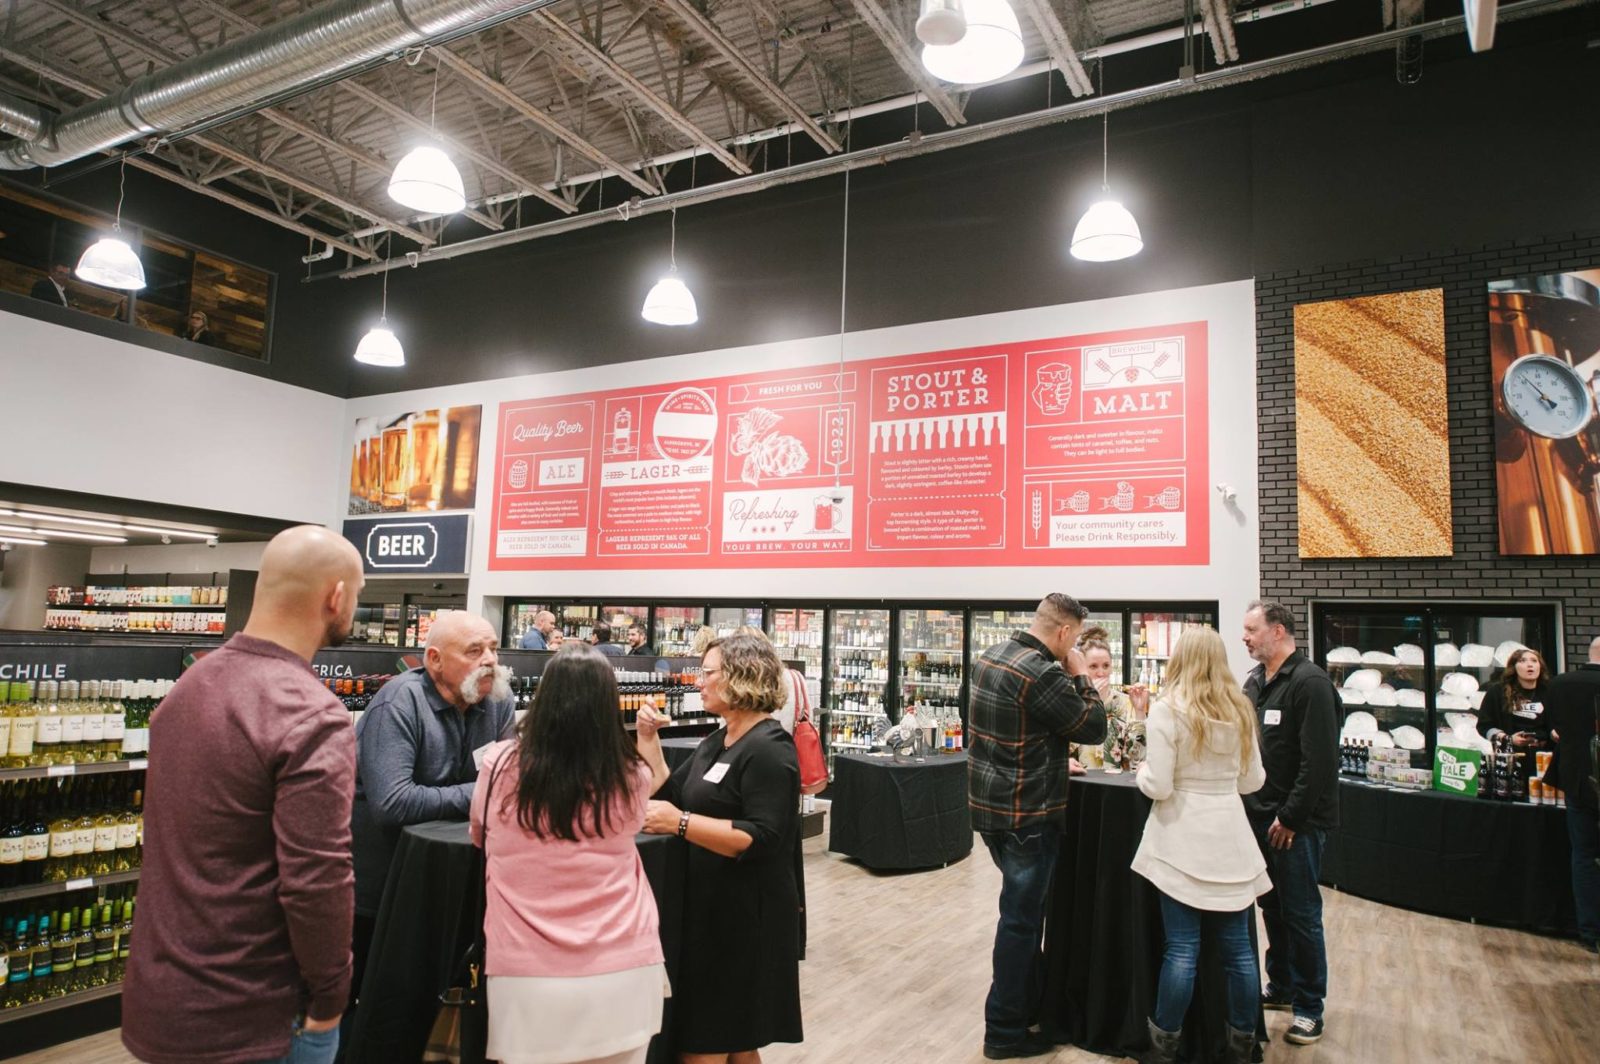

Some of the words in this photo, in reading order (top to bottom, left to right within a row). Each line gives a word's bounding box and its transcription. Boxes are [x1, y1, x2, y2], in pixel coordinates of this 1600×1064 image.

[759, 387, 784, 395] FRESH
[786, 384, 802, 392] FOR
[804, 381, 822, 390] YOU
[887, 369, 966, 393] STOUT
[971, 367, 988, 384] &
[887, 387, 989, 412] PORTER
[1094, 391, 1172, 415] MALT
[513, 423, 553, 441] Quality
[555, 420, 583, 436] Beer
[832, 417, 844, 457] 1922
[546, 464, 576, 479] ALE
[631, 464, 681, 480] LAGER
[729, 496, 799, 533] Refreshing
[1056, 521, 1078, 530] Your
[1080, 519, 1135, 531] community
[1138, 519, 1164, 528] cares
[1056, 532, 1086, 542] Please
[1088, 531, 1113, 541] Drink
[1117, 530, 1178, 542] Responsibly.
[378, 534, 425, 556] BEER
[726, 543, 751, 551] YOUR
[823, 541, 848, 549] WAY.
[0, 664, 67, 679] CHILE
[1443, 764, 1467, 777] YALE
